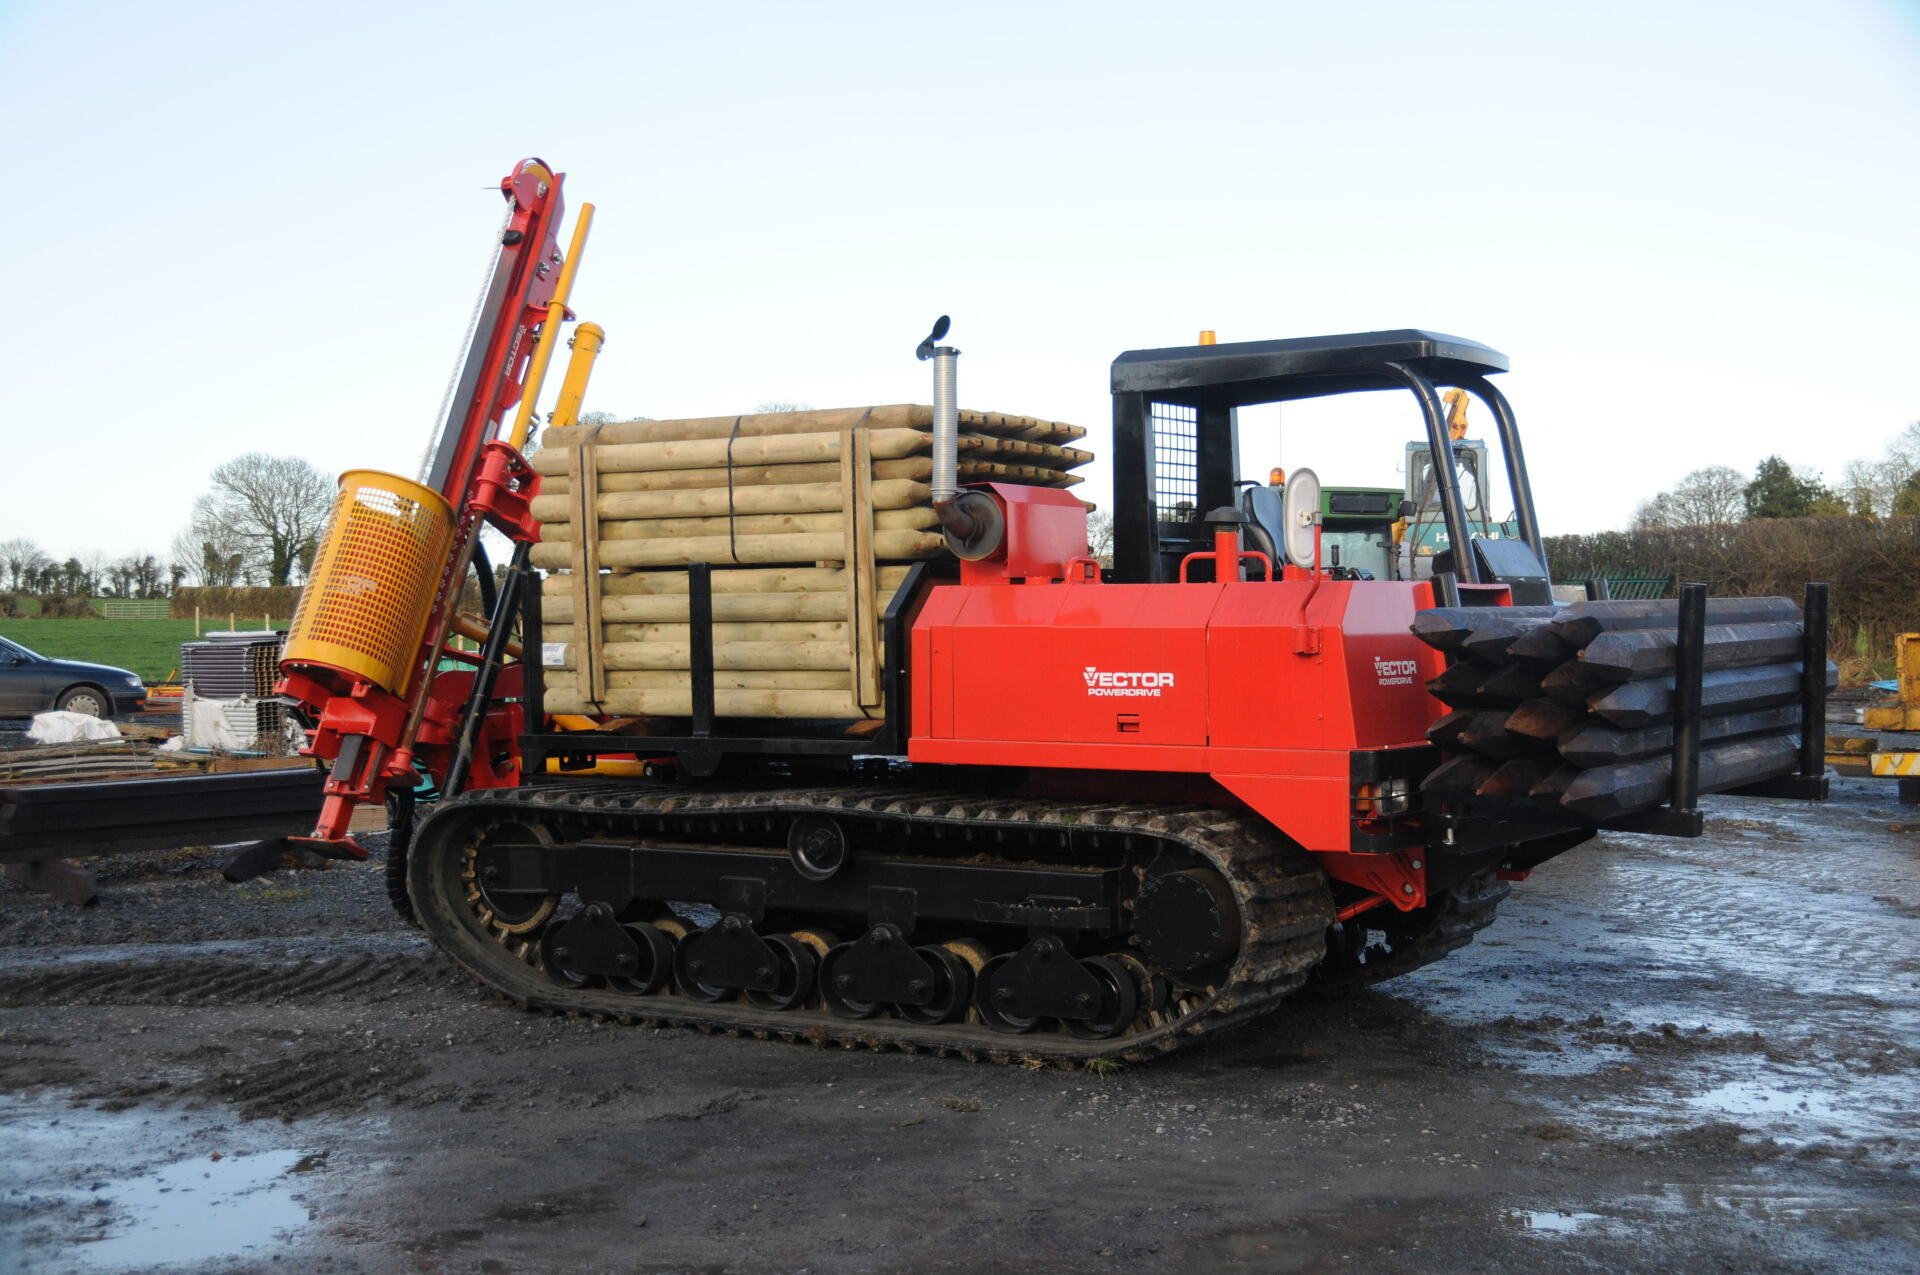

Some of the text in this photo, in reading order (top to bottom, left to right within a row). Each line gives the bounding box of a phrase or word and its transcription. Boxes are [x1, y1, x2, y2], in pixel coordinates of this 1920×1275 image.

[504, 324, 527, 377] VECTOR
[1374, 656, 1417, 676] VECTOR
[1082, 666, 1175, 687] VECTOR
[1087, 688, 1161, 697] POWERDRIVE
